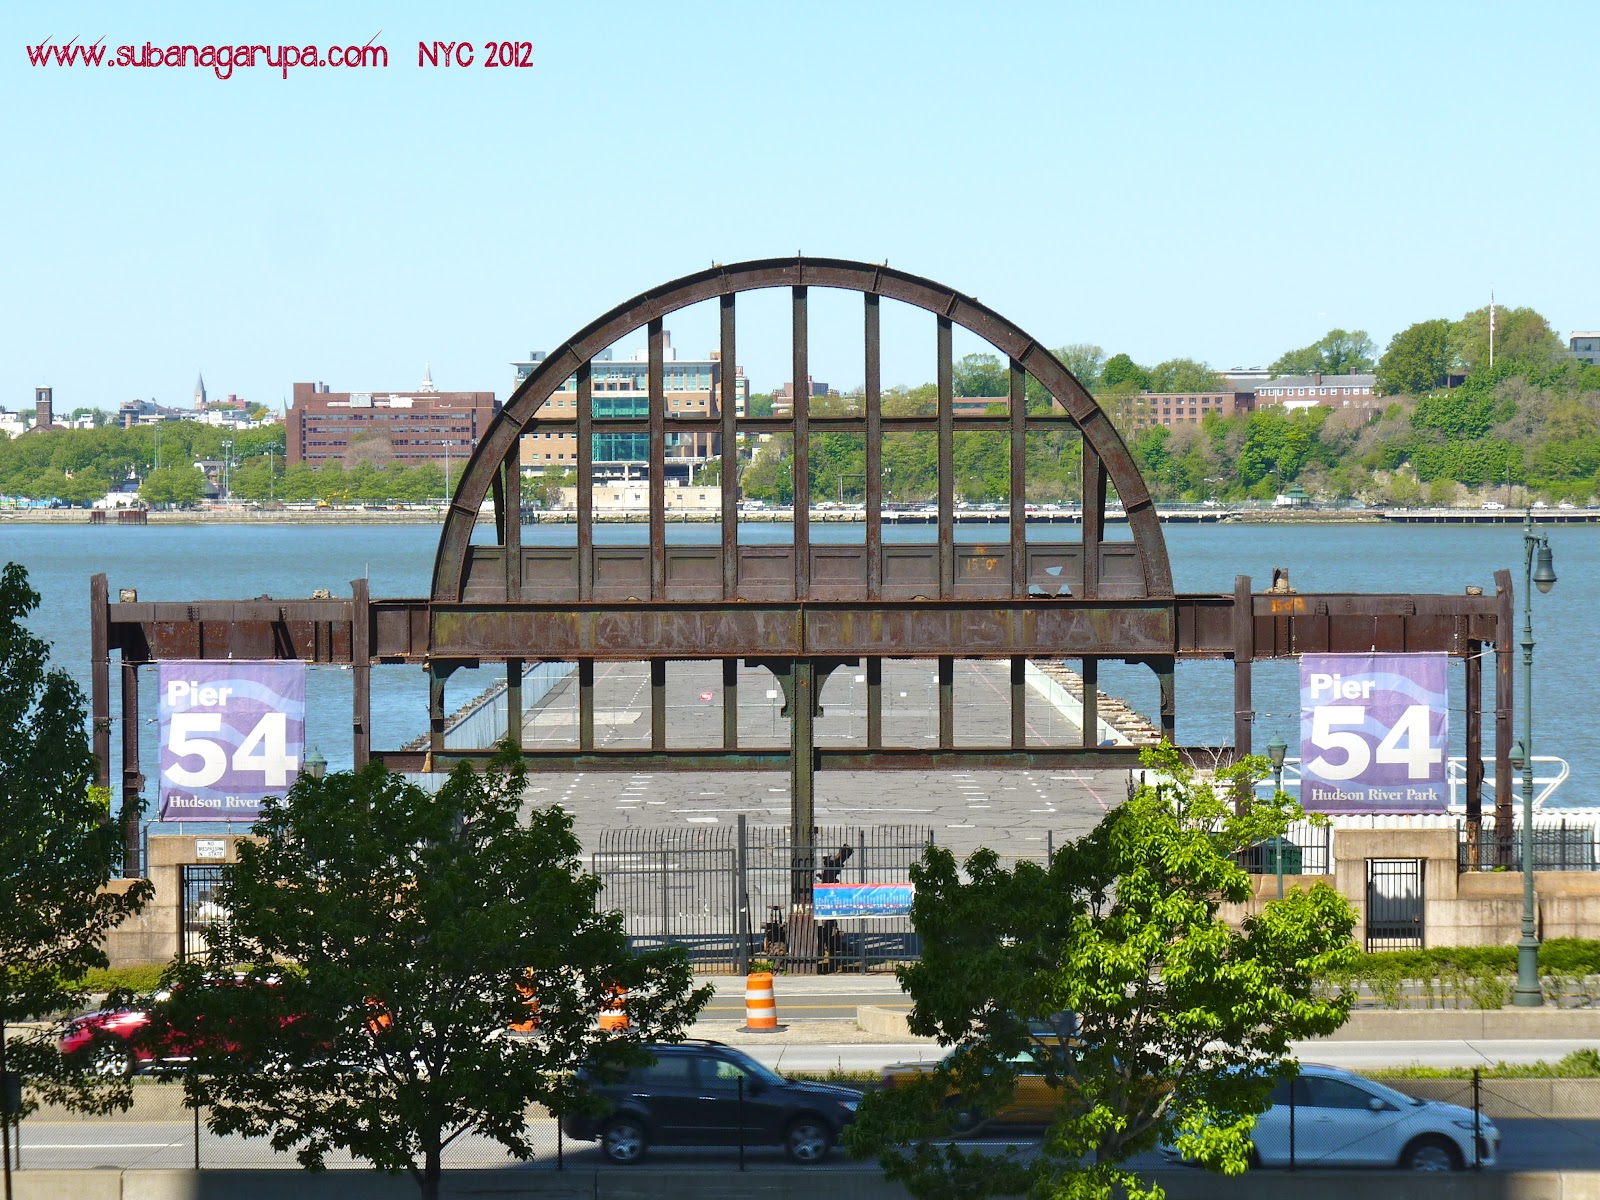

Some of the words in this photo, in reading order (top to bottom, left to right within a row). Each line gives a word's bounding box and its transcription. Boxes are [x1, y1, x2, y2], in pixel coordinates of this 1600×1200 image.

[167, 680, 233, 707] Pier
[1310, 673, 1376, 699] Pier
[164, 712, 298, 788] 54
[1307, 704, 1442, 781] 54
[169, 795, 222, 808] Hudson
[225, 796, 260, 808] River
[1311, 788, 1365, 801] Hudson
[1368, 788, 1403, 801] River
[1406, 788, 1437, 801] Park
